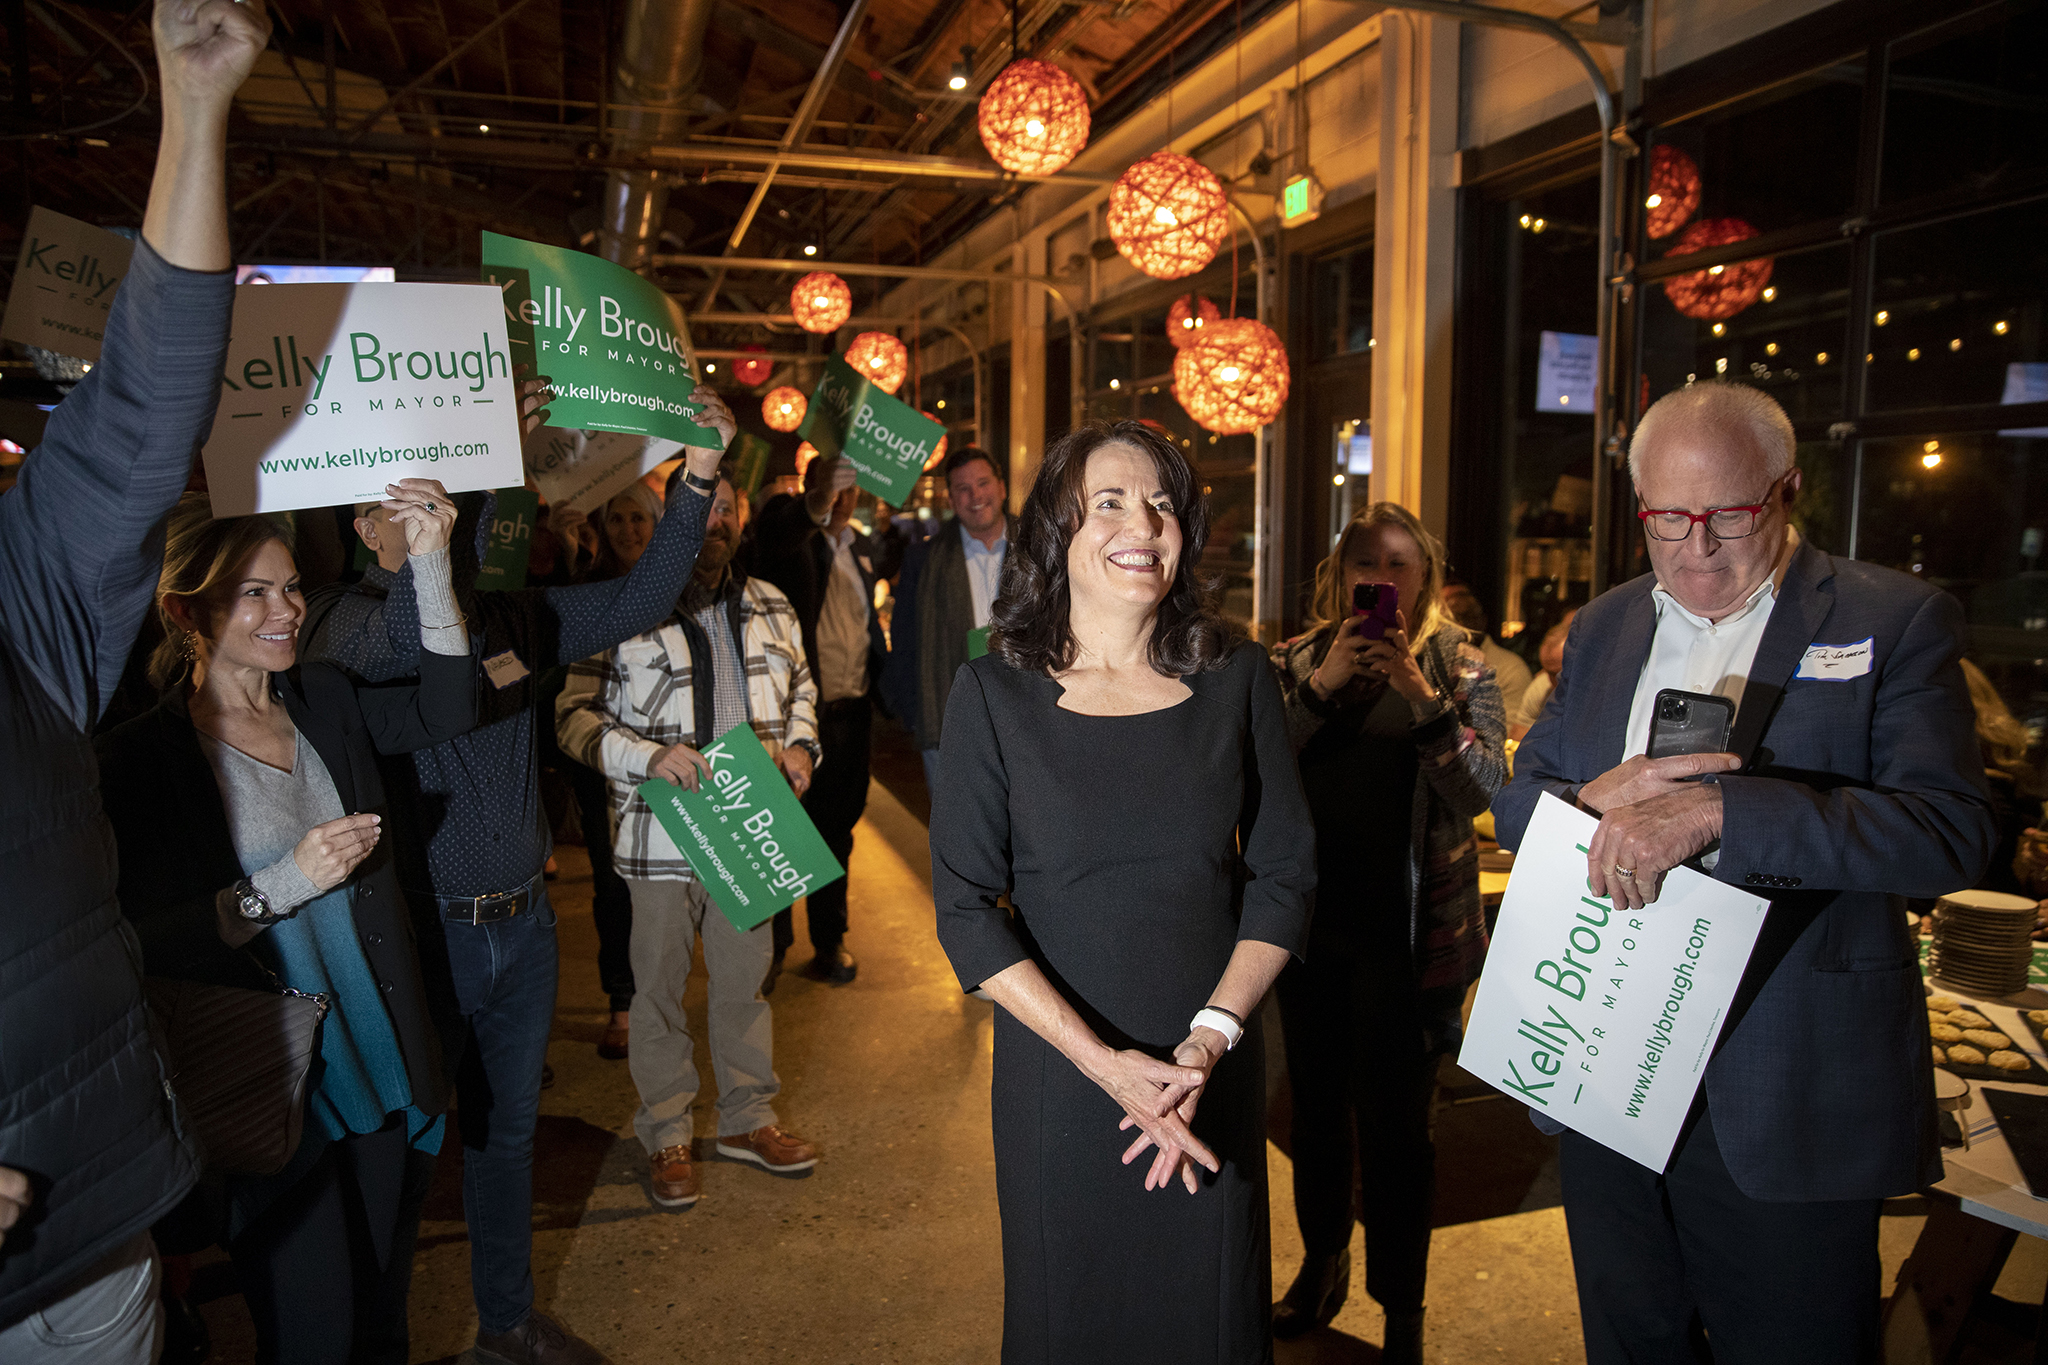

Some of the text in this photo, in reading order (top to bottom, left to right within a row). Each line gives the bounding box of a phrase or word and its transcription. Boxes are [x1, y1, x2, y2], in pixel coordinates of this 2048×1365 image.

[25, 238, 117, 298] Kelly
[222, 331, 508, 400] elly Brough
[542, 340, 676, 376] FOR MAYOR
[600, 296, 690, 369] Broug
[282, 395, 463, 418] FOR MAYOR
[853, 403, 929, 465] Brough
[259, 441, 490, 474] www.kellybrough.com
[670, 795, 751, 906] www.kellybrough.com
[703, 741, 814, 898] Kelly Brough
[705, 794, 768, 880] FOR MAYOR
[1501, 842, 1615, 1107] Kelly Brou
[1581, 917, 1644, 1074] FOR MAYOR
[1624, 917, 1712, 1119] www.kellybrough.com
